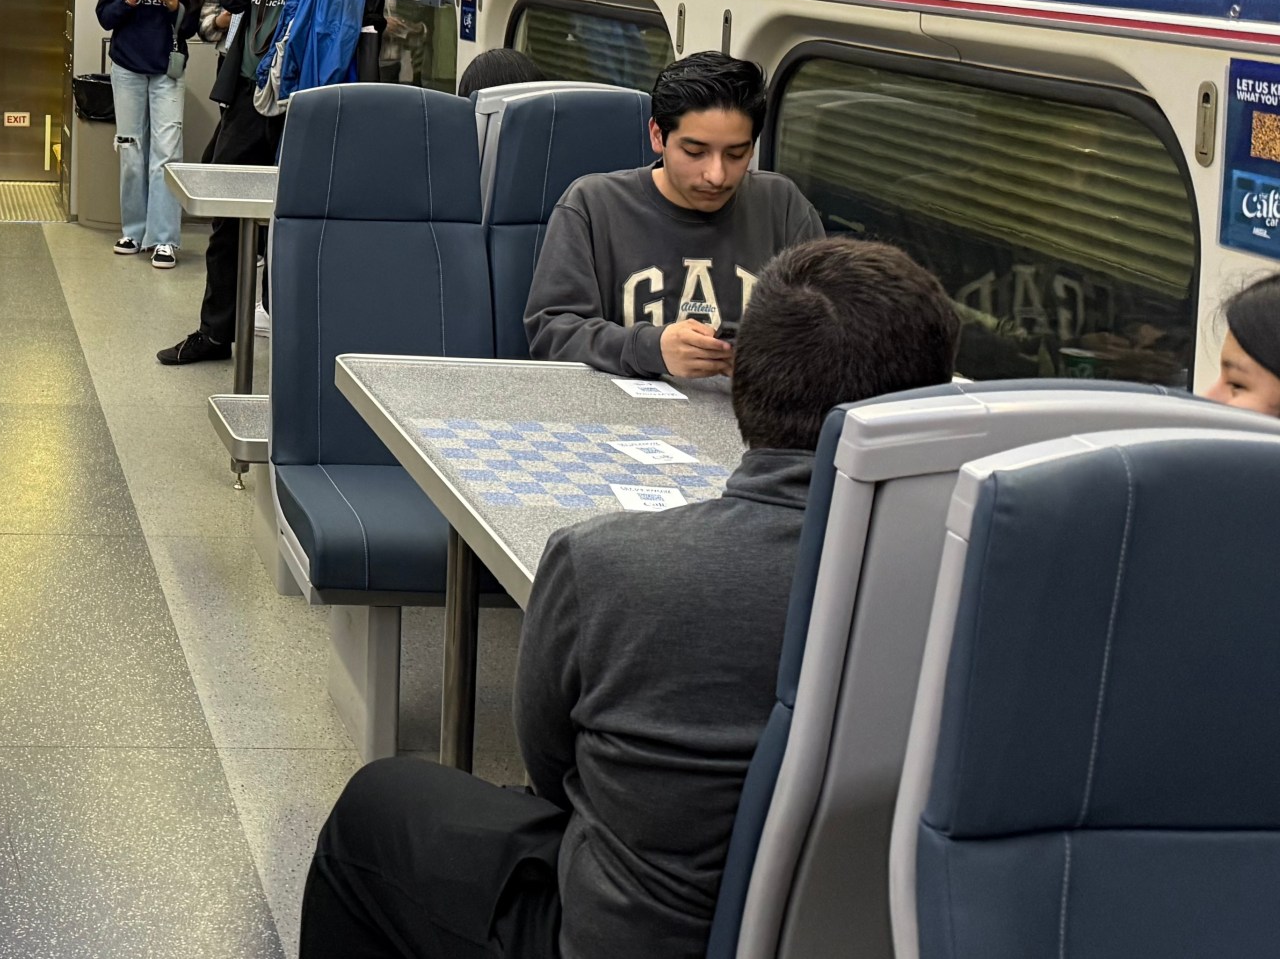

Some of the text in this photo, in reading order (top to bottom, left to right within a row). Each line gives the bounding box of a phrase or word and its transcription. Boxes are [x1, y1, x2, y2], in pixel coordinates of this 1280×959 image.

[1237, 79, 1253, 91] LET
[1255, 81, 1269, 93] US
[1237, 91, 1278, 106] WHAT YOU
[1266, 218, 1278, 227] car
[681, 302, 717, 312] Athletic
